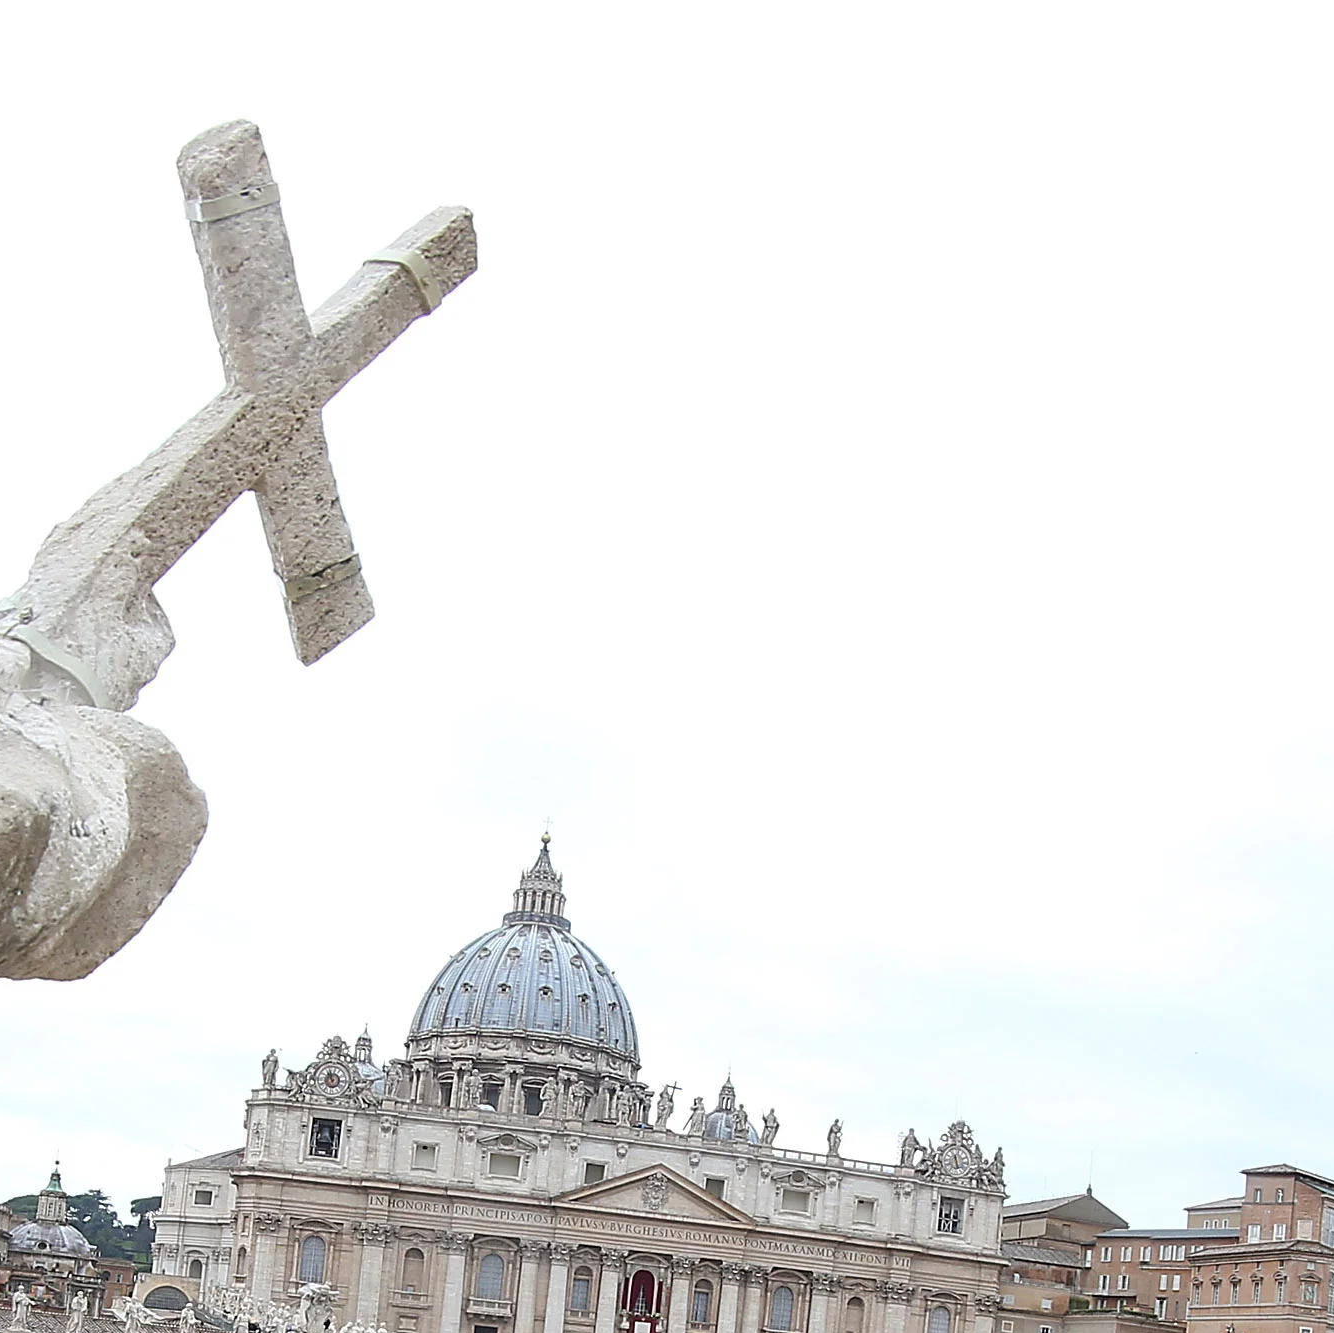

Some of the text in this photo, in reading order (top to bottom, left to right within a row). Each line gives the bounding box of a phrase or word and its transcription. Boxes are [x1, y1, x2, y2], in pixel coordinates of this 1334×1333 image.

[370, 1195, 386, 1206] IN
[388, 1199, 450, 1214] HONOREM
[454, 1204, 516, 1221] PRINCIPIS
[518, 1213, 555, 1225] APOST
[558, 1217, 598, 1230] PAVLVS
[610, 1222, 682, 1239] BVRGHESIVS
[685, 1232, 744, 1248] ROMANVS
[893, 1257, 910, 1268] VII
